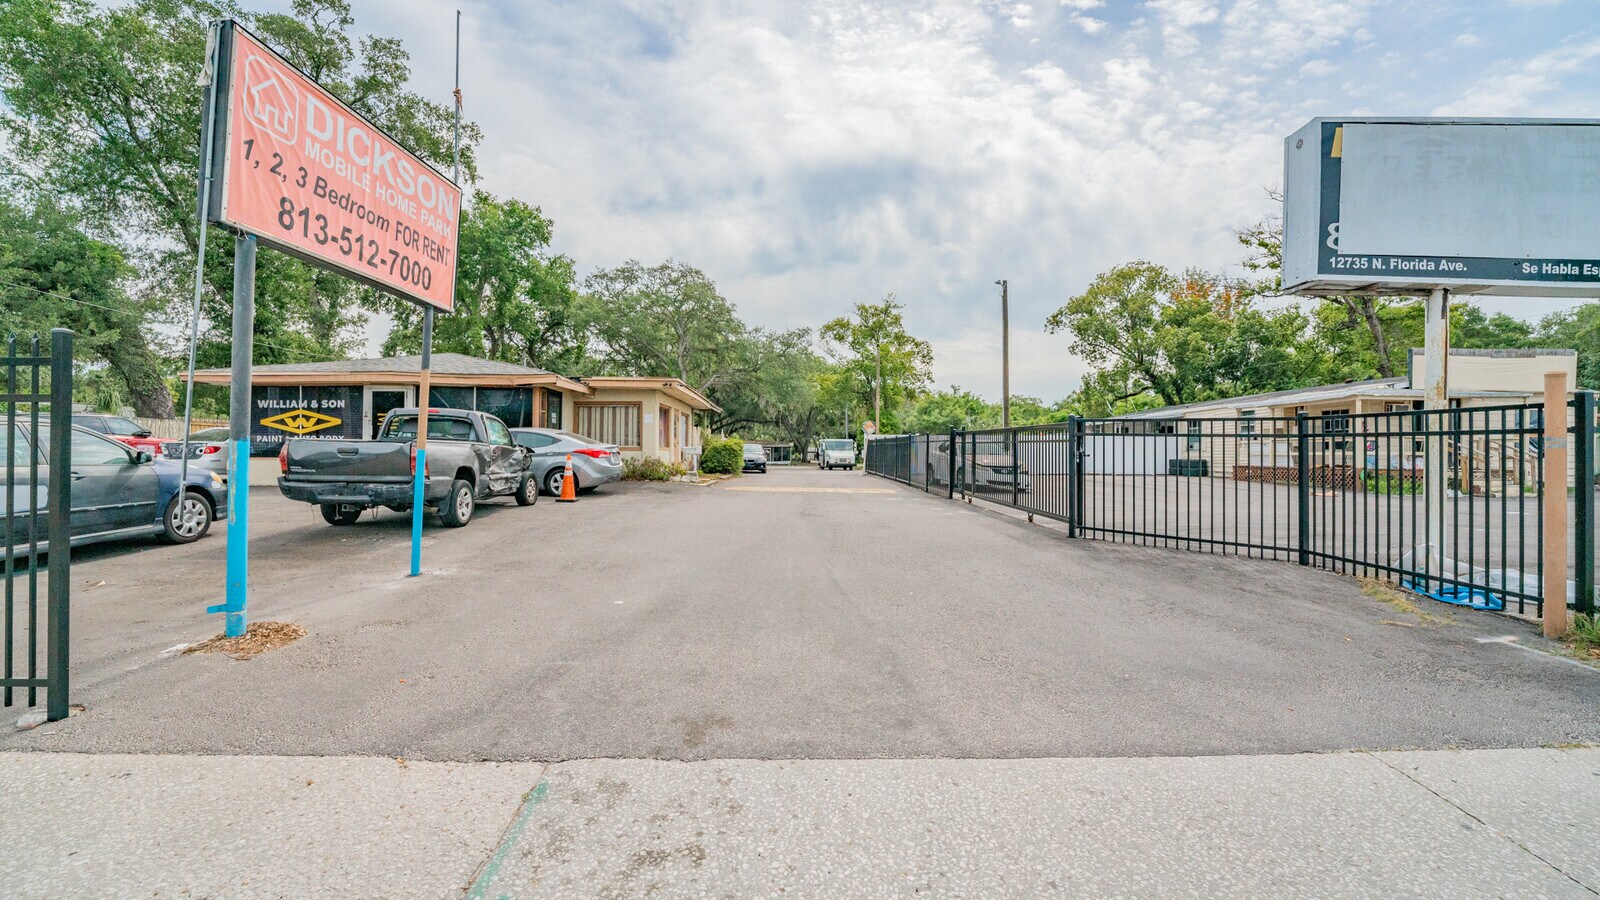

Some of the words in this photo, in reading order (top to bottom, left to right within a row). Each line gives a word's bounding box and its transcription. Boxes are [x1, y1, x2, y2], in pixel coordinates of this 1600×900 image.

[305, 94, 454, 222] DICKSON
[243, 138, 260, 170] 1,
[269, 152, 287, 183] 2,
[295, 166, 307, 189] 3
[313, 175, 390, 233] Bedroom
[395, 221, 419, 249] FOR
[422, 235, 450, 267] RENT
[304, 137, 372, 193] MOBILE
[375, 183, 417, 221] HOME
[420, 211, 452, 240] PARK
[277, 196, 432, 291] 813-512-7000
[1329, 256, 1369, 270] 12735
[1372, 257, 1386, 270] N.
[1390, 257, 1435, 271] Florida
[1438, 259, 1467, 272] Ave.
[1521, 262, 1538, 275] Se
[1542, 262, 1579, 275] Habla
[1583, 263, 1600, 278] Es
[257, 400, 308, 409] WILLIAM
[311, 400, 319, 409] &
[321, 400, 345, 409] SON
[256, 435, 283, 443] PAINT
